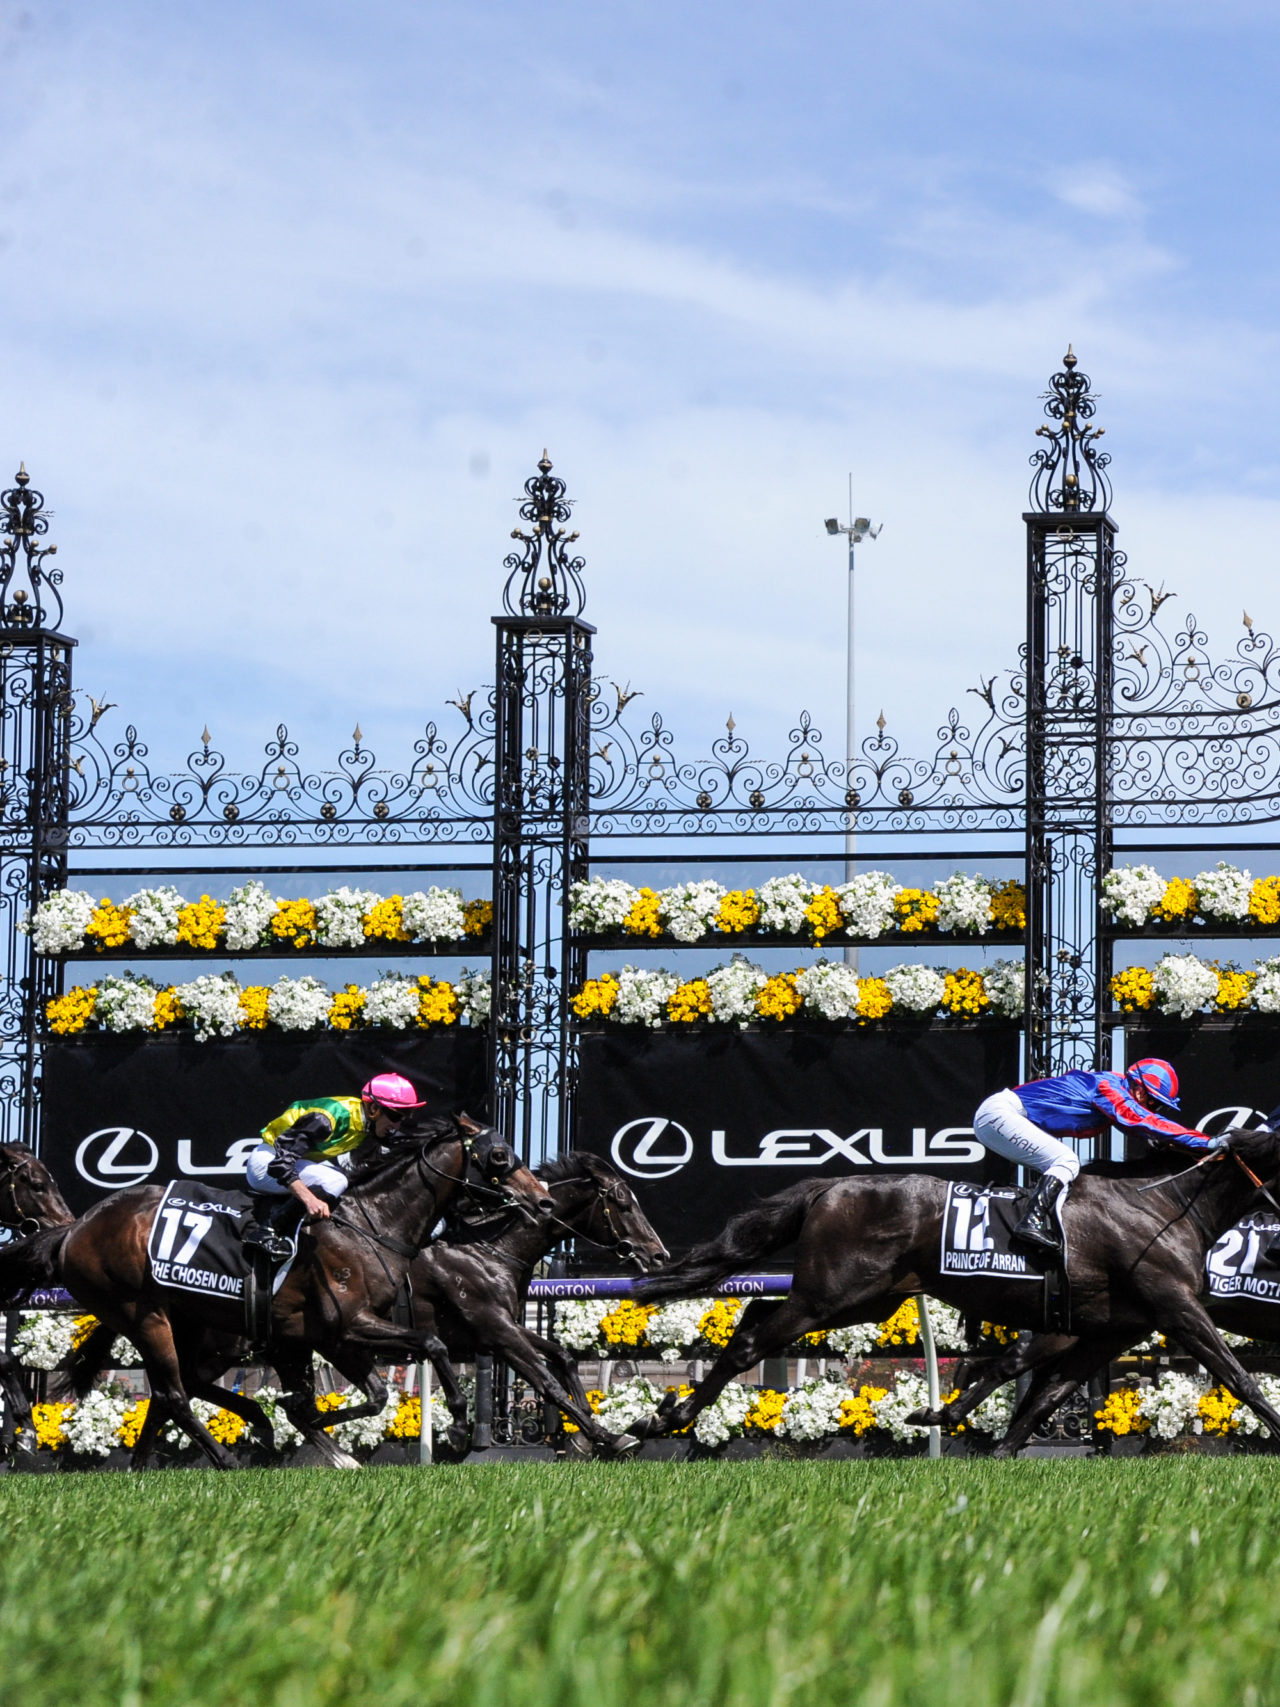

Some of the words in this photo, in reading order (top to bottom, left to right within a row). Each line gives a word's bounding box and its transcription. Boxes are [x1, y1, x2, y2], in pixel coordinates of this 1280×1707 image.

[711, 1127, 987, 1167] LEXUS
[1008, 1133, 1040, 1154] KAH
[156, 1207, 213, 1265] 17
[952, 1196, 995, 1251] 12
[945, 1251, 980, 1270] PRINCE
[979, 1251, 992, 1269] OF
[991, 1252, 1026, 1272] ARRAN
[1209, 1229, 1260, 1277] 21
[152, 1260, 171, 1279] THE
[171, 1264, 218, 1290] CHOSEN
[218, 1274, 244, 1294] ONE
[527, 1283, 596, 1297] MINGTON
[1209, 1273, 1242, 1293] TIGER
